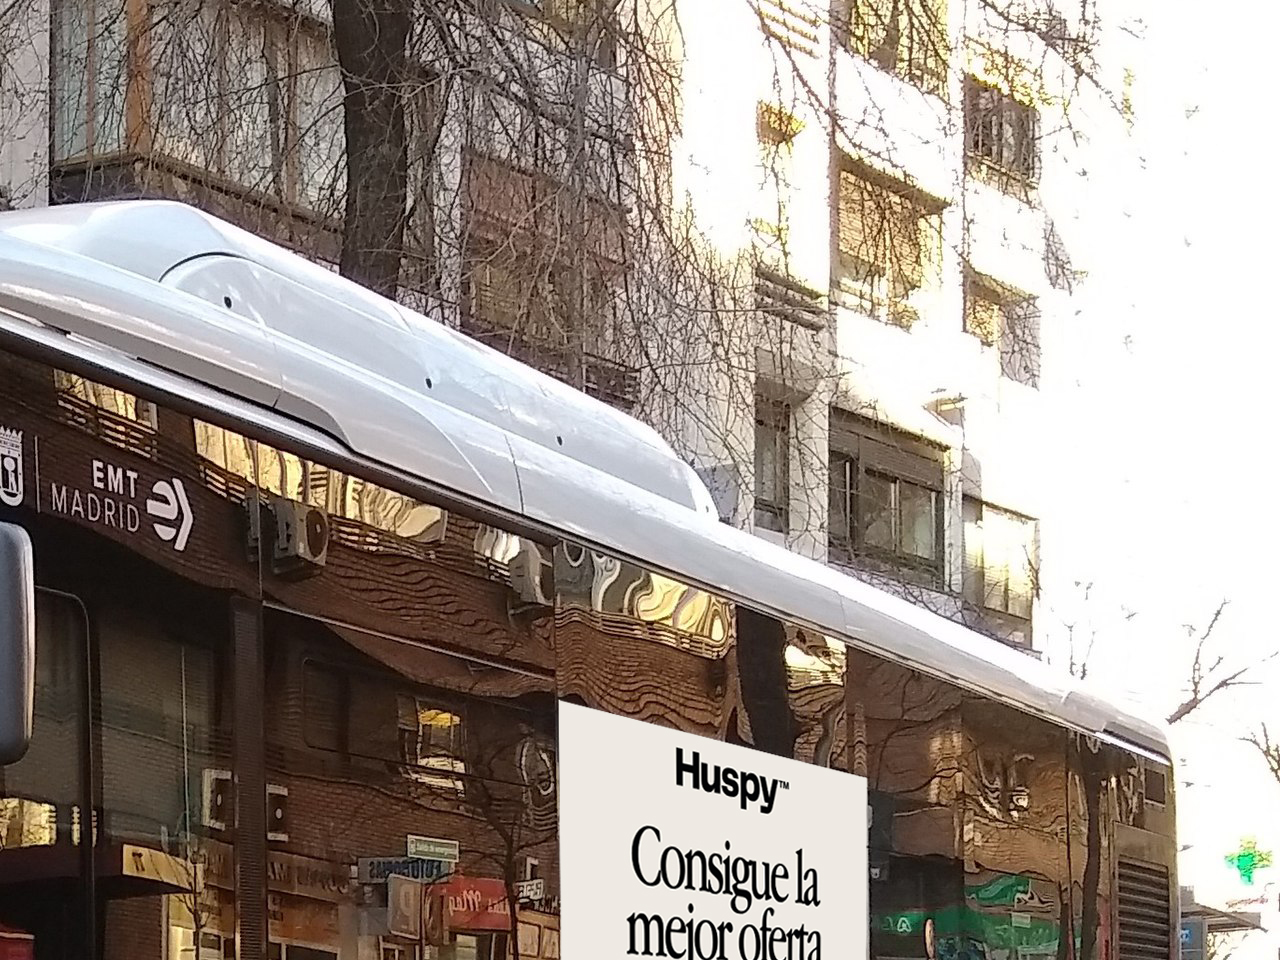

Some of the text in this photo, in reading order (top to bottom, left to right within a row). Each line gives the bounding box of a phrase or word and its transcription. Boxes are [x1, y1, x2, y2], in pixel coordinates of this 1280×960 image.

[92, 459, 138, 498] EMT
[51, 482, 140, 533] MADRID
[631, 825, 821, 914] Consigue la
